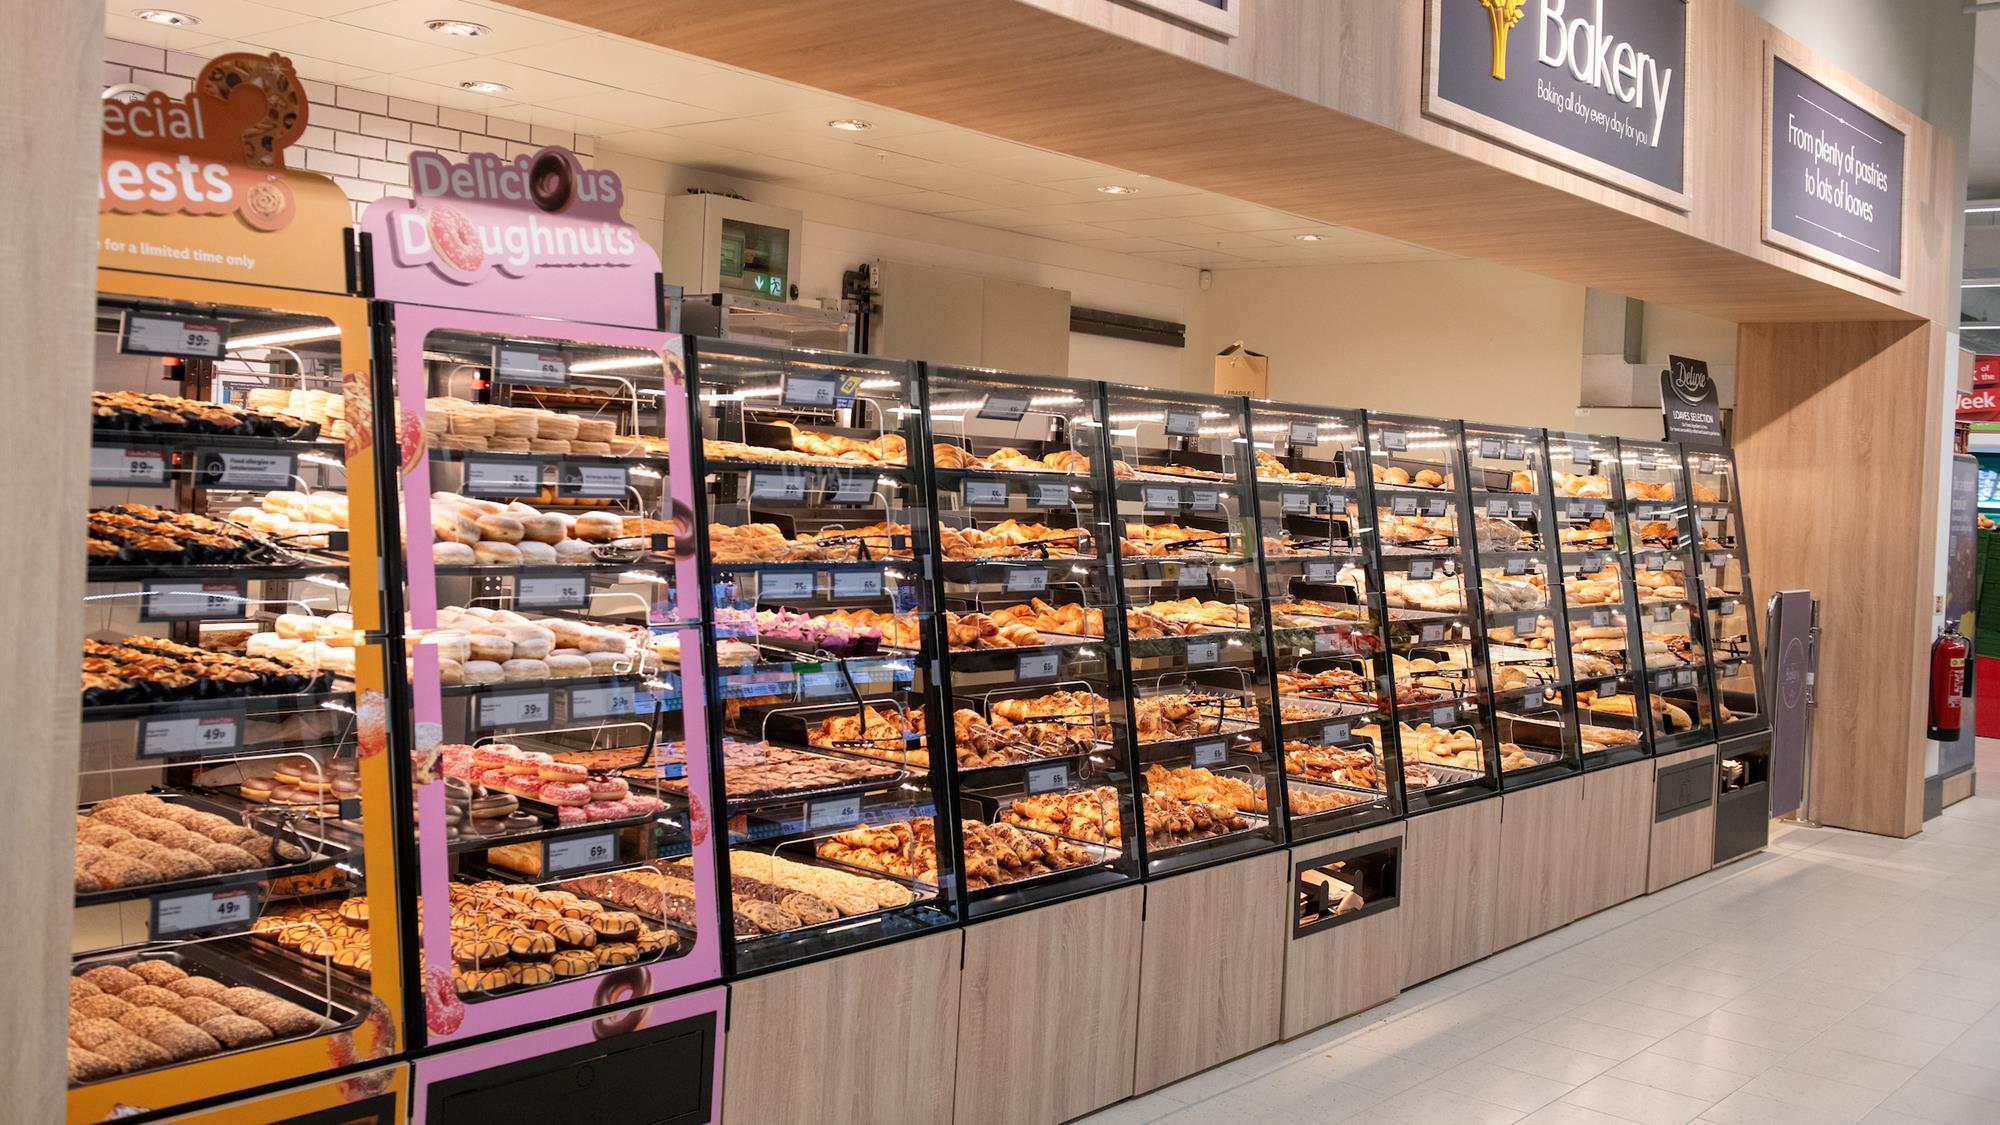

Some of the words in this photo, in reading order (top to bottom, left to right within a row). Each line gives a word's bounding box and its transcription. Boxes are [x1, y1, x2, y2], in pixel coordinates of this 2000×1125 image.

[1538, 0, 1672, 147] Bakery
[1537, 78, 1564, 113] Baking
[1565, 91, 1575, 112] all
[1575, 95, 1590, 125] day
[1590, 109, 1610, 133] every
[1610, 111, 1625, 140] day
[1625, 116, 1635, 139] for
[1635, 128, 1648, 147] you
[1788, 113, 1814, 154] From
[1815, 128, 1844, 177] plenty
[1844, 145, 1856, 175] of
[1855, 160, 1888, 192] pastries
[99, 155, 233, 203] ests
[1805, 167, 1815, 196] to
[1816, 167, 1833, 205] lots
[1833, 178, 1845, 209] of
[1845, 181, 1874, 223] loaves
[104, 238, 125, 252] for
[128, 243, 137, 254] a
[140, 242, 190, 260] limited
[193, 249, 224, 264] time
[226, 254, 256, 269] only
[1676, 361, 1707, 392] Deluxe
[1980, 364, 1990, 372] of
[1690, 412, 1714, 424] SELECTION
[524, 704, 540, 715] 39p
[203, 728, 226, 740] 49p
[590, 845, 607, 857] 69p
[217, 902, 240, 914] 49p
